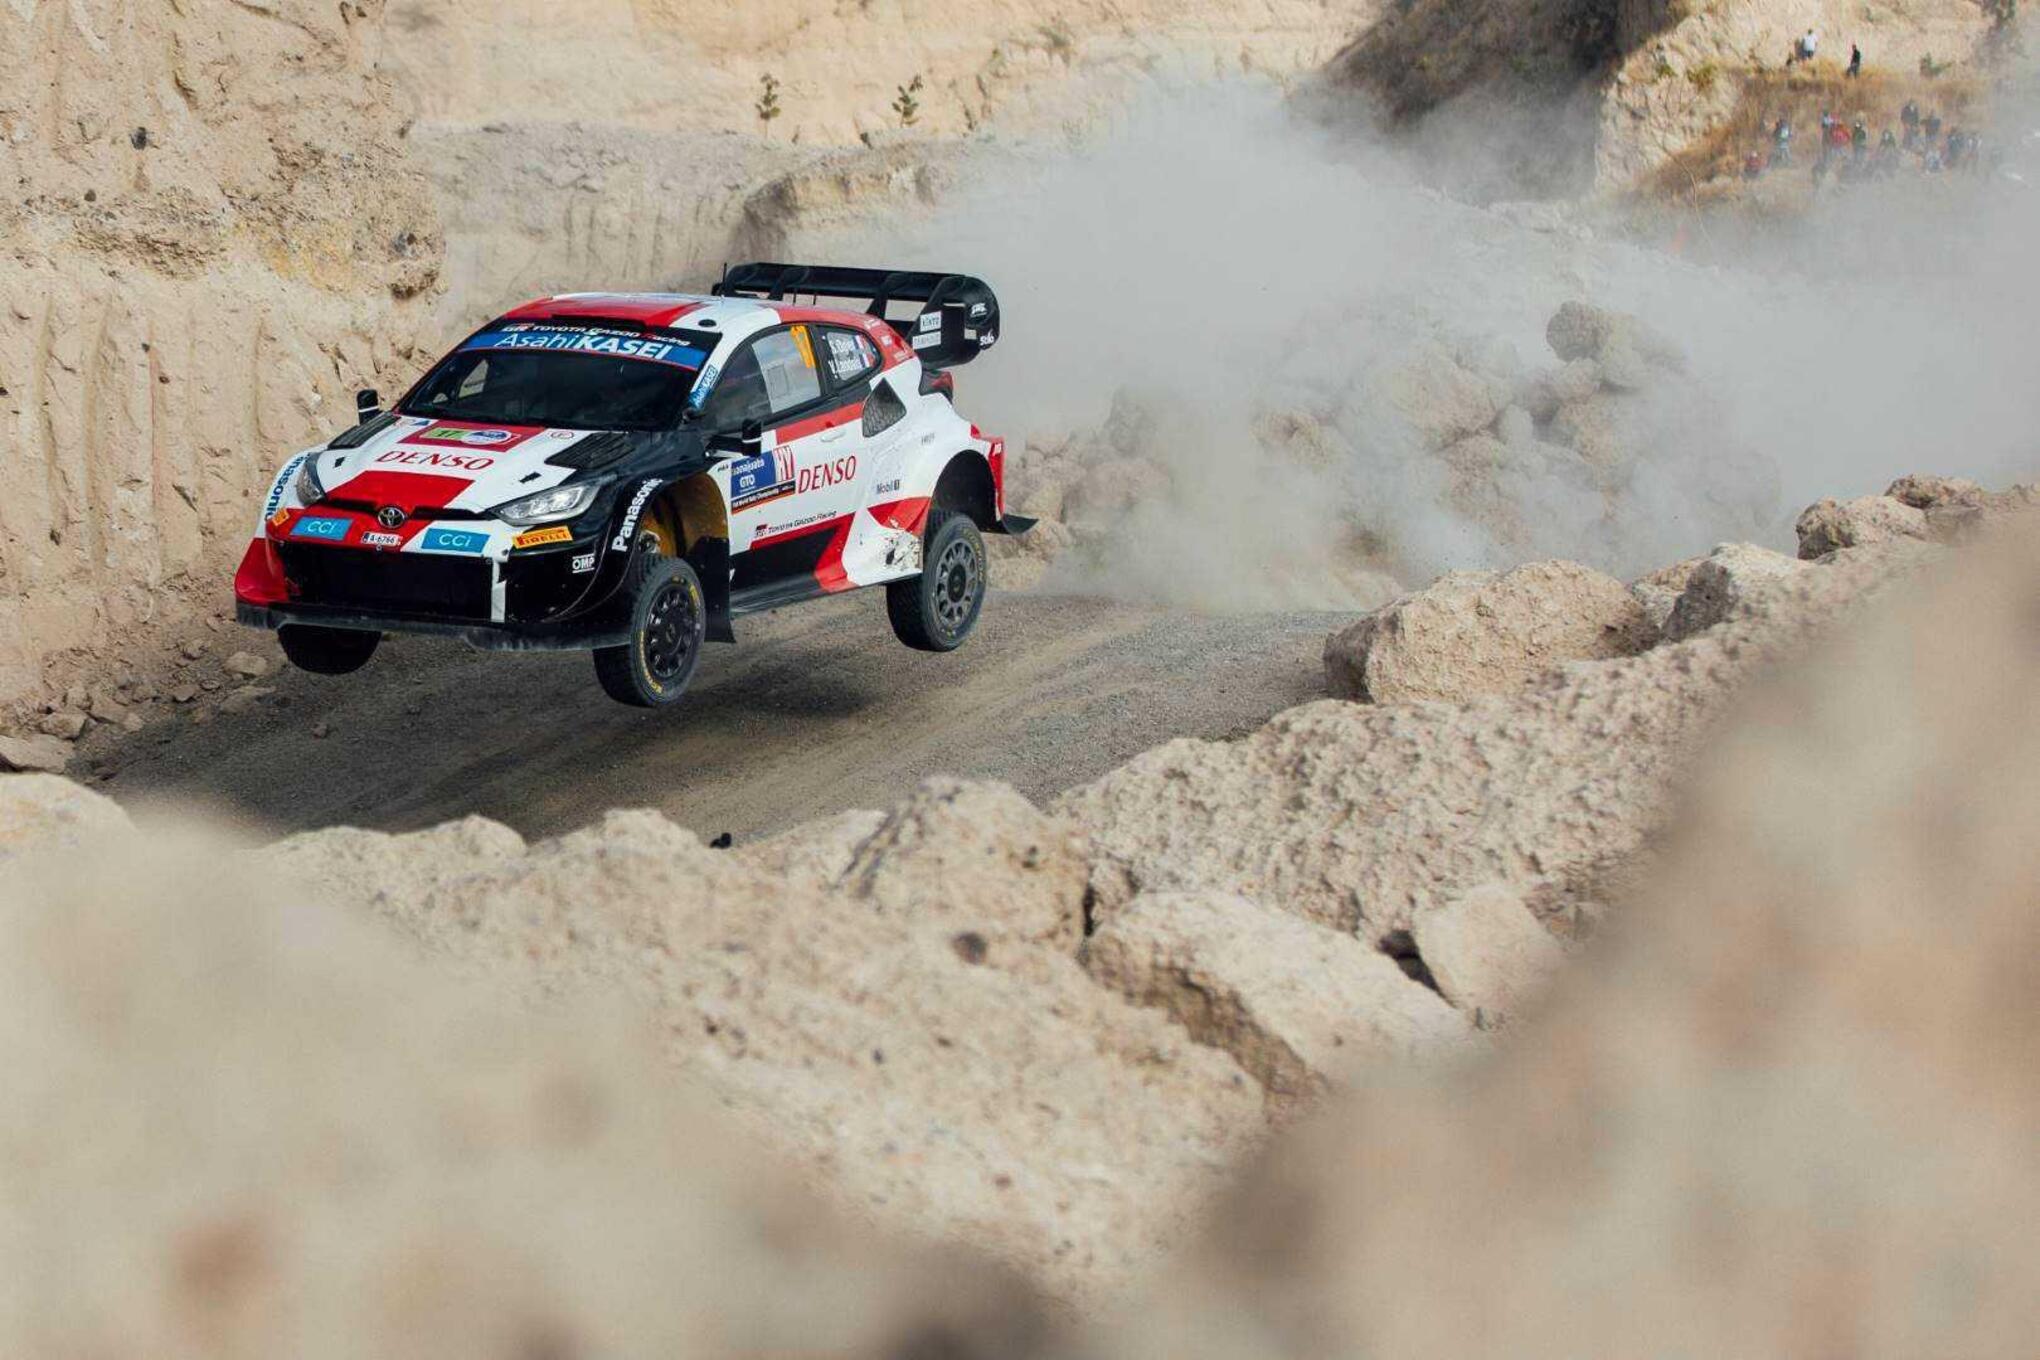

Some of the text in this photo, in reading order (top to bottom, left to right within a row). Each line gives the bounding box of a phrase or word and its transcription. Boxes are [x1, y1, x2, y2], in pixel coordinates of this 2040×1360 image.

[533, 325, 587, 334] TOYOTA
[586, 327, 640, 338] GAZOO
[644, 332, 691, 347] Racing
[377, 450, 495, 471] DENSO
[798, 455, 857, 494] DENSO
[612, 478, 663, 552] Panasonic
[516, 528, 568, 546] PIRELLI
[572, 557, 595, 570] OMP
